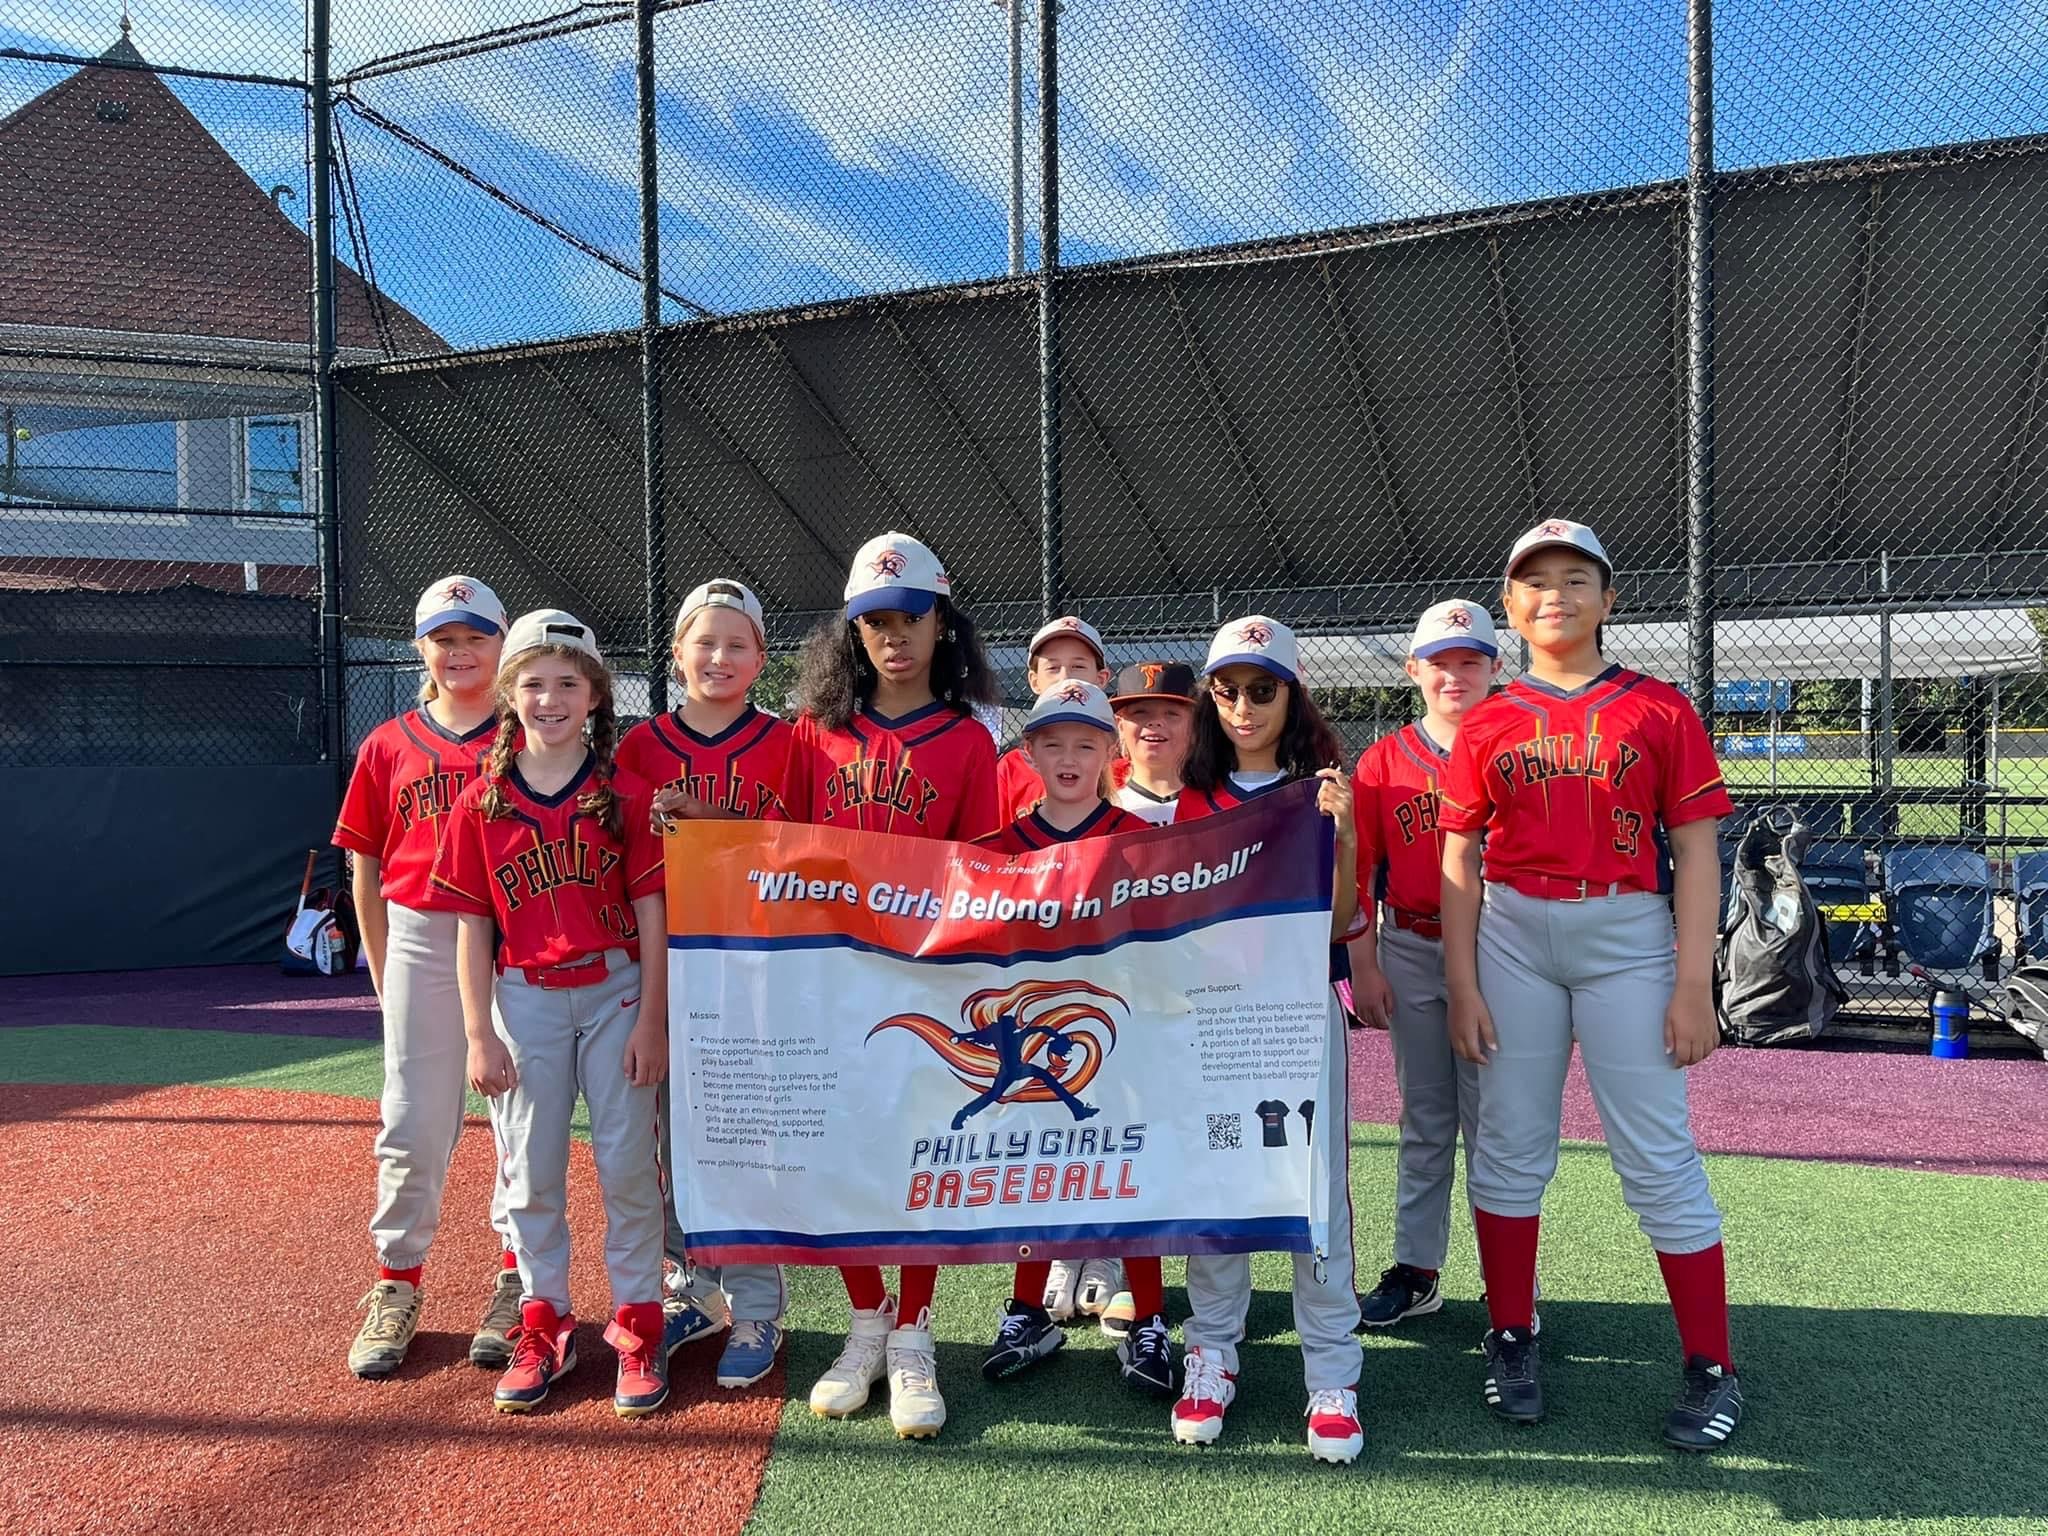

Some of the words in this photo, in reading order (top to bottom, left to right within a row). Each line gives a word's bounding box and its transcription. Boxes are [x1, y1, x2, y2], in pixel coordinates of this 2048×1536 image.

[1496, 734, 1639, 794] PHILLY
[823, 759, 939, 824] PHILLY
[1611, 805, 1644, 857] 33
[494, 839, 619, 911] PHILLY
[867, 882, 943, 920] Girls
[947, 889, 1062, 929] Belong
[1072, 893, 1102, 921] in
[1185, 986, 1206, 997] Show
[1195, 1006, 1217, 1016] Shop
[1219, 1006, 1233, 1014] our
[1234, 1004, 1254, 1013] Girls
[1255, 1003, 1285, 1013] Belong
[1285, 1001, 1324, 1011] collection
[689, 1012, 720, 1020] Mission
[1197, 1017, 1213, 1026] and
[1215, 1016, 1237, 1025] show
[1238, 1015, 1256, 1024] that
[1257, 1014, 1273, 1025] you
[1274, 1013, 1303, 1022] believe
[1198, 1028, 1214, 1037] and
[1215, 1027, 1234, 1038] girls
[1235, 1026, 1263, 1036] belong
[1264, 1025, 1274, 1033] in
[701, 1036, 730, 1045] Provide
[732, 1037, 760, 1045] women
[761, 1038, 777, 1046] and
[778, 1037, 797, 1048] girls
[799, 1036, 816, 1045] with
[1201, 1040, 1209, 1048] A
[1210, 1039, 1239, 1049] portion
[1240, 1038, 1250, 1047] of
[1251, 1037, 1262, 1046] all
[1263, 1036, 1286, 1046] sales
[1287, 1037, 1298, 1046] go
[1299, 1035, 1318, 1044] back
[700, 1048, 721, 1056] more
[722, 1048, 774, 1057] opportunities
[775, 1049, 785, 1057] to
[786, 1047, 812, 1056] coach
[813, 1047, 829, 1055] and
[1200, 1051, 1214, 1059] the
[1216, 1050, 1251, 1060] program
[1252, 1049, 1261, 1057] to
[1263, 1048, 1295, 1058] support
[1296, 1048, 1310, 1056] our
[701, 1057, 717, 1067] play
[1201, 1060, 1262, 1071] developmental
[1263, 1060, 1280, 1068] and
[702, 1070, 732, 1079] Provide
[733, 1071, 777, 1082] mentorship
[778, 1073, 788, 1081] to
[822, 1071, 838, 1079] and
[1202, 1072, 1251, 1082] tournament
[1252, 1070, 1288, 1081] baseball
[703, 1080, 734, 1090] become
[735, 1082, 767, 1091] mentors
[768, 1083, 808, 1093] ourselves
[809, 1083, 821, 1091] for
[822, 1082, 836, 1091] the
[703, 1091, 720, 1100] next
[721, 1092, 764, 1102] generation
[704, 1103, 738, 1114] Cultivate
[751, 1107, 800, 1116] environment
[802, 1107, 826, 1116] where
[705, 1115, 721, 1123] girls
[706, 1126, 720, 1134] and
[760, 1127, 777, 1137] With
[793, 1128, 810, 1139] they
[706, 1134, 738, 1144] baseball
[910, 1130, 1032, 1168] PHILLY
[1037, 1123, 1147, 1157] GIRLS
[905, 1159, 1140, 1211] BASEBALL
